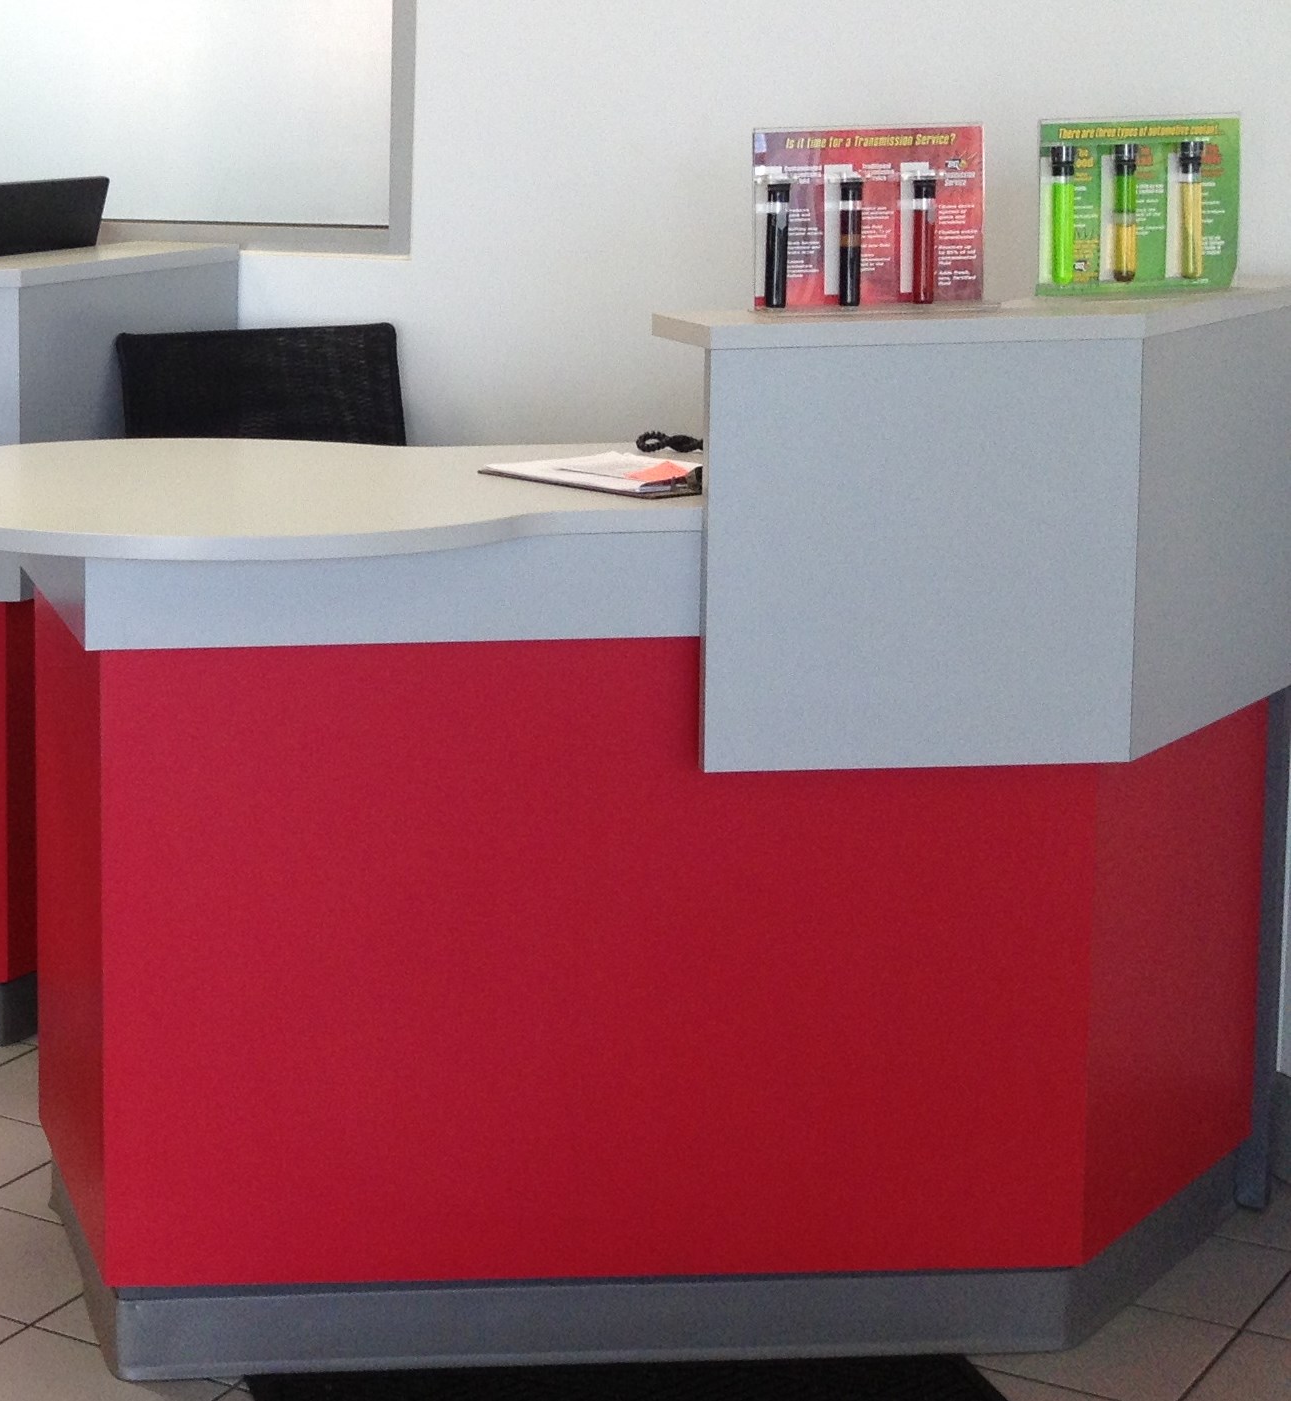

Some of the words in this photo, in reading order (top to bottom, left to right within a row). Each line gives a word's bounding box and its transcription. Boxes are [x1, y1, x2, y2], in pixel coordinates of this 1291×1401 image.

[1059, 127, 1081, 139] There
[1081, 129, 1095, 139] are
[1095, 127, 1117, 138] three
[1117, 126, 1138, 139] types
[1138, 126, 1147, 137] of
[1148, 125, 1190, 137] automotive
[785, 138, 795, 149] Is
[796, 137, 805, 149] it
[806, 137, 827, 149] time
[828, 136, 844, 148] for
[845, 137, 852, 147] a
[854, 135, 914, 147] Transmission
[915, 133, 956, 146] Service?
